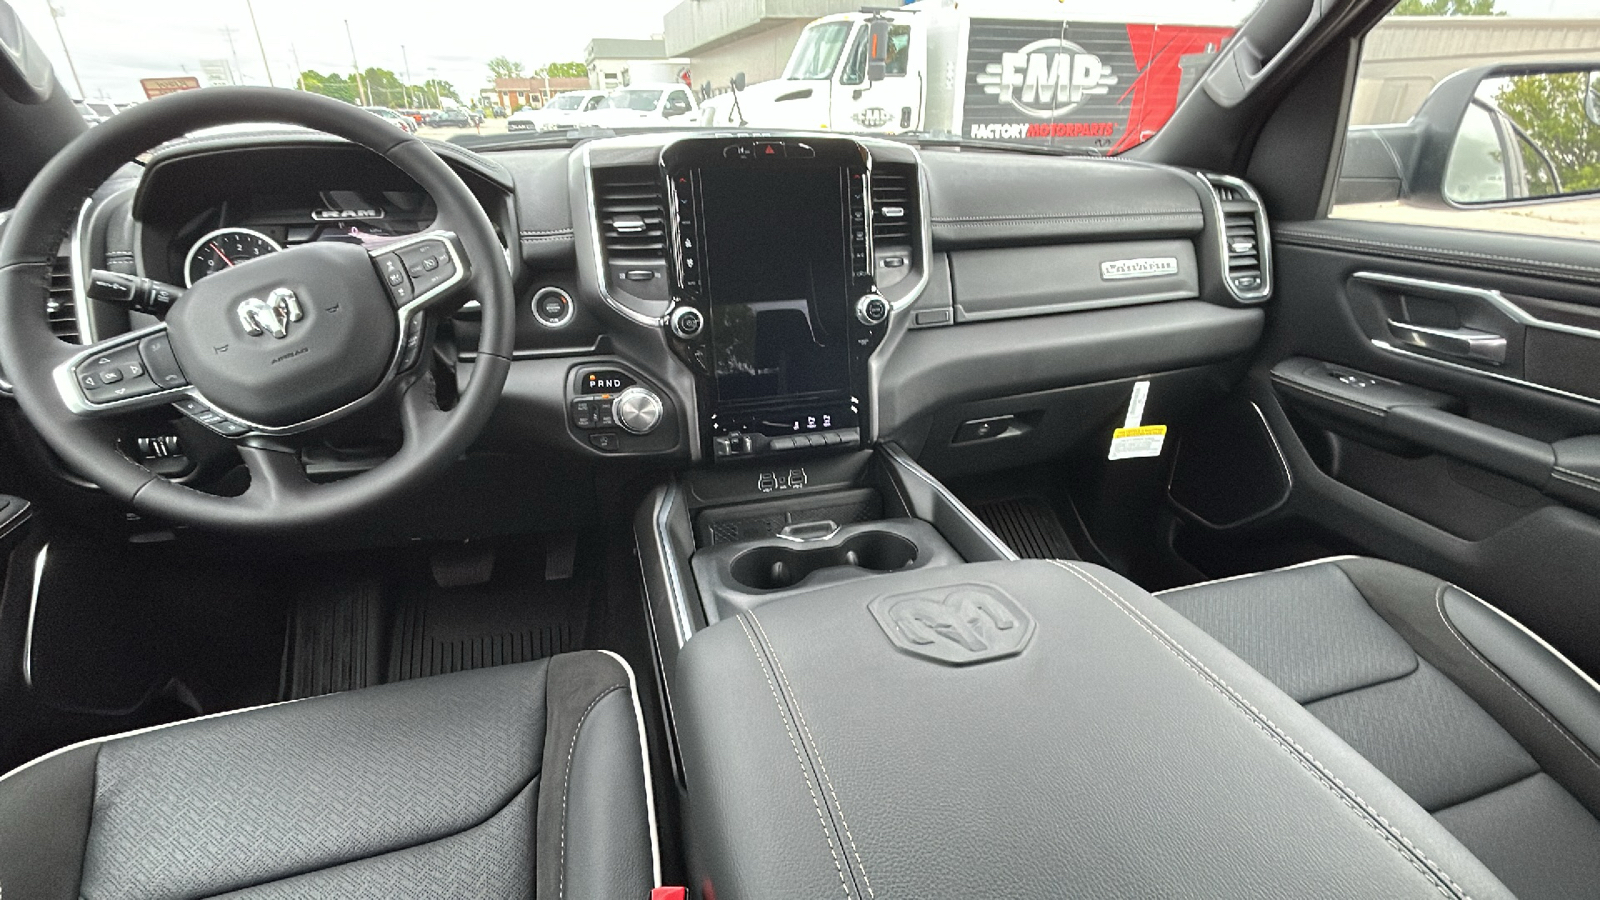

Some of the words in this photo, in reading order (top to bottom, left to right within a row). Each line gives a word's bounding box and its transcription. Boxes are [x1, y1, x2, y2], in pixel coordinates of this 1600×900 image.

[999, 52, 1101, 103] FMP
[322, 209, 376, 218] RAM
[236, 244, 243, 252] 2
[253, 248, 260, 256] 3
